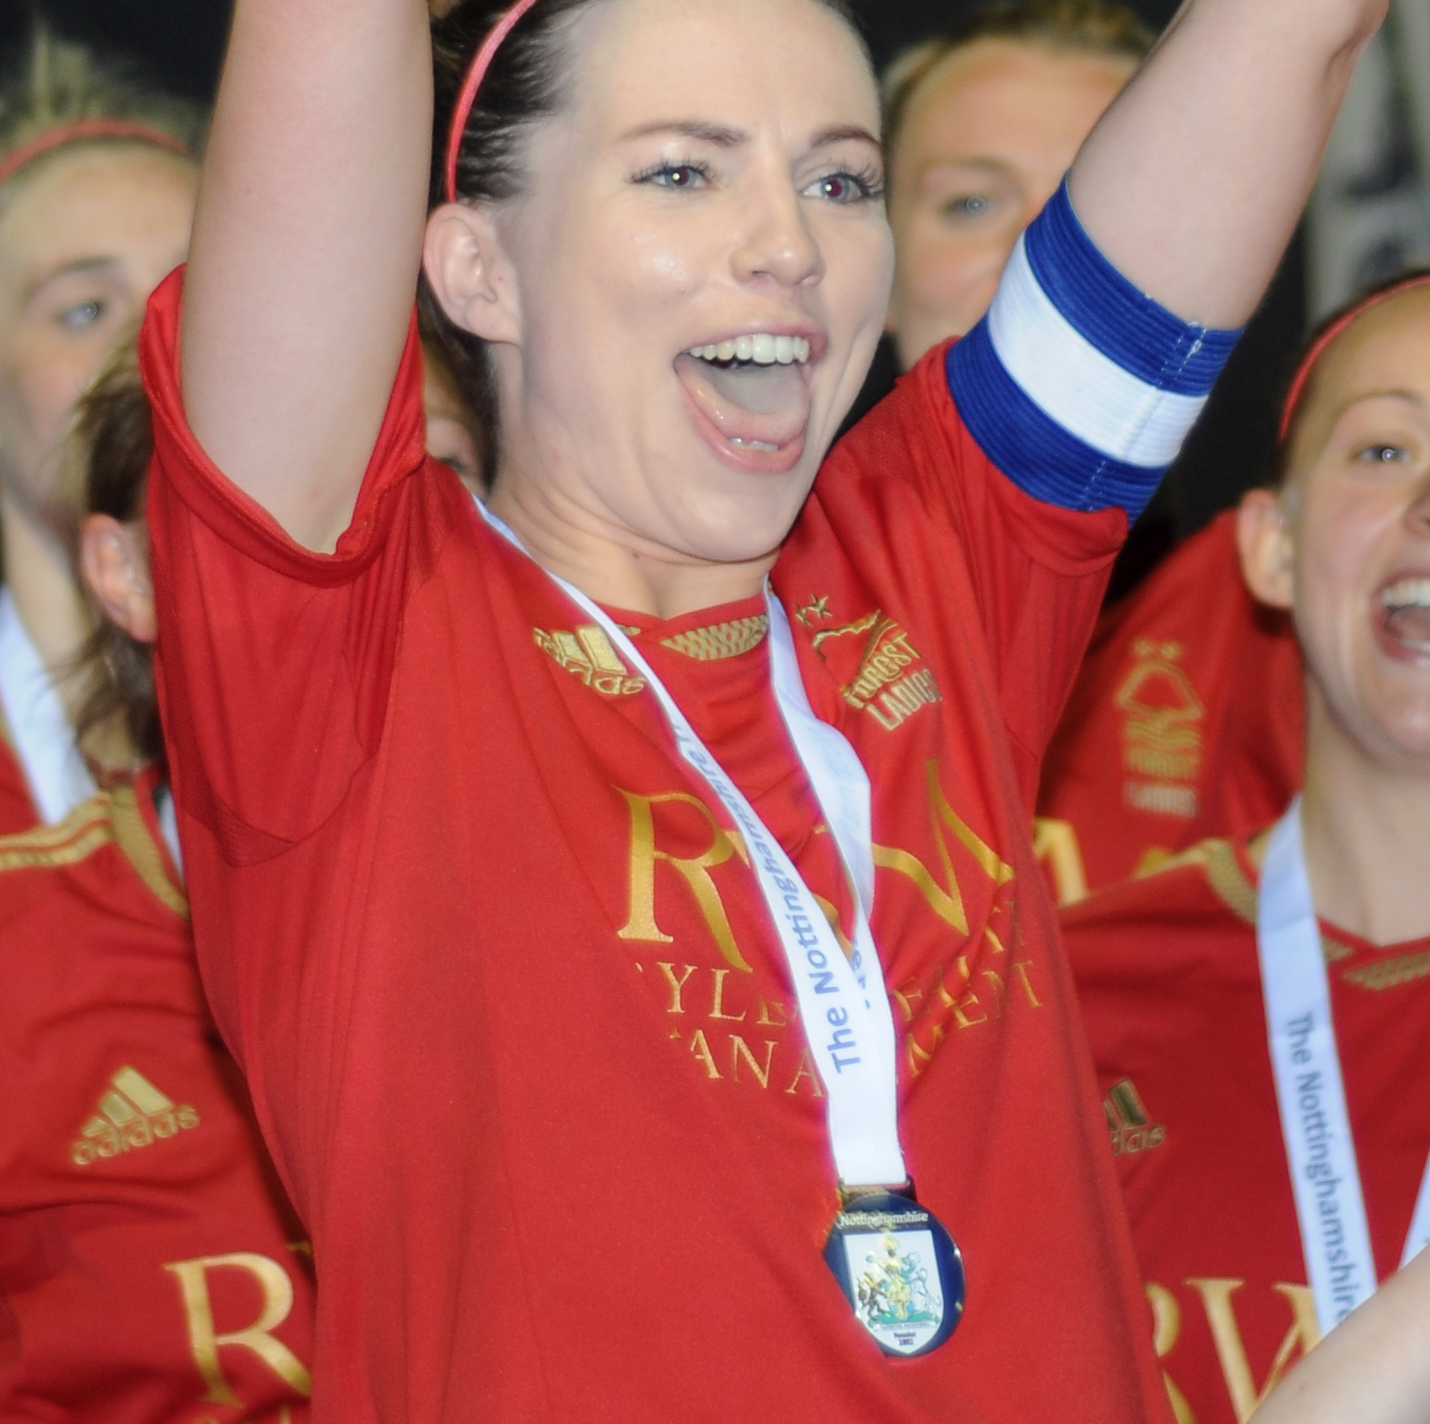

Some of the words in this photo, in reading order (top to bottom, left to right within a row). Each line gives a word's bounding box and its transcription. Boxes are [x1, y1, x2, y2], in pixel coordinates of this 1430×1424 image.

[610, 758, 1017, 974] RM
[687, 747, 841, 996] Nottinghamshire
[827, 1005, 861, 1075] The
[1287, 1012, 1315, 1066] The
[72, 1103, 201, 1166] adidas
[838, 1210, 930, 1228] Nottinghamshire
